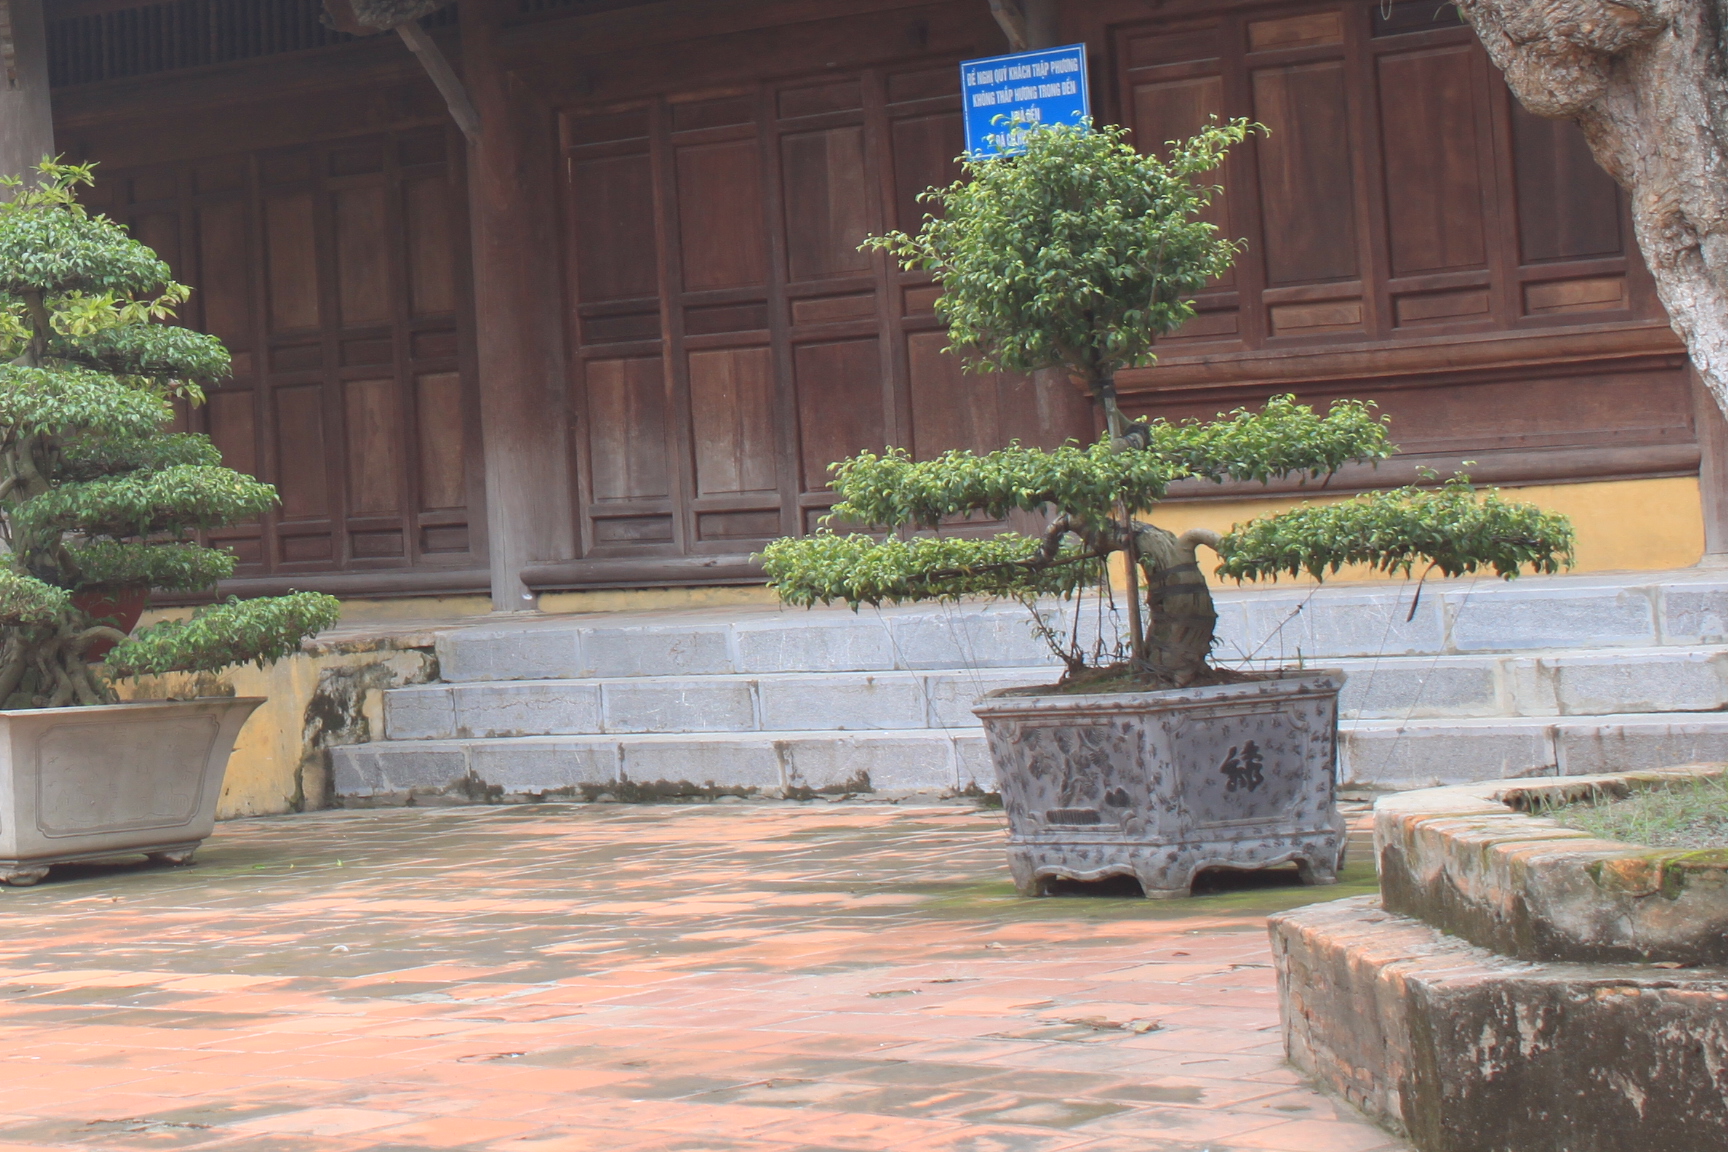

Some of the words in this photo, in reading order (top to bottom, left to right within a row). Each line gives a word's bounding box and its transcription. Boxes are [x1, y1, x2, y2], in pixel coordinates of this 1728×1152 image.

[994, 65, 1007, 84] QUÝ
[1008, 63, 1032, 81] KHÁCH
[973, 90, 996, 108] KHÔNG
[1038, 82, 1062, 98] TRONG
